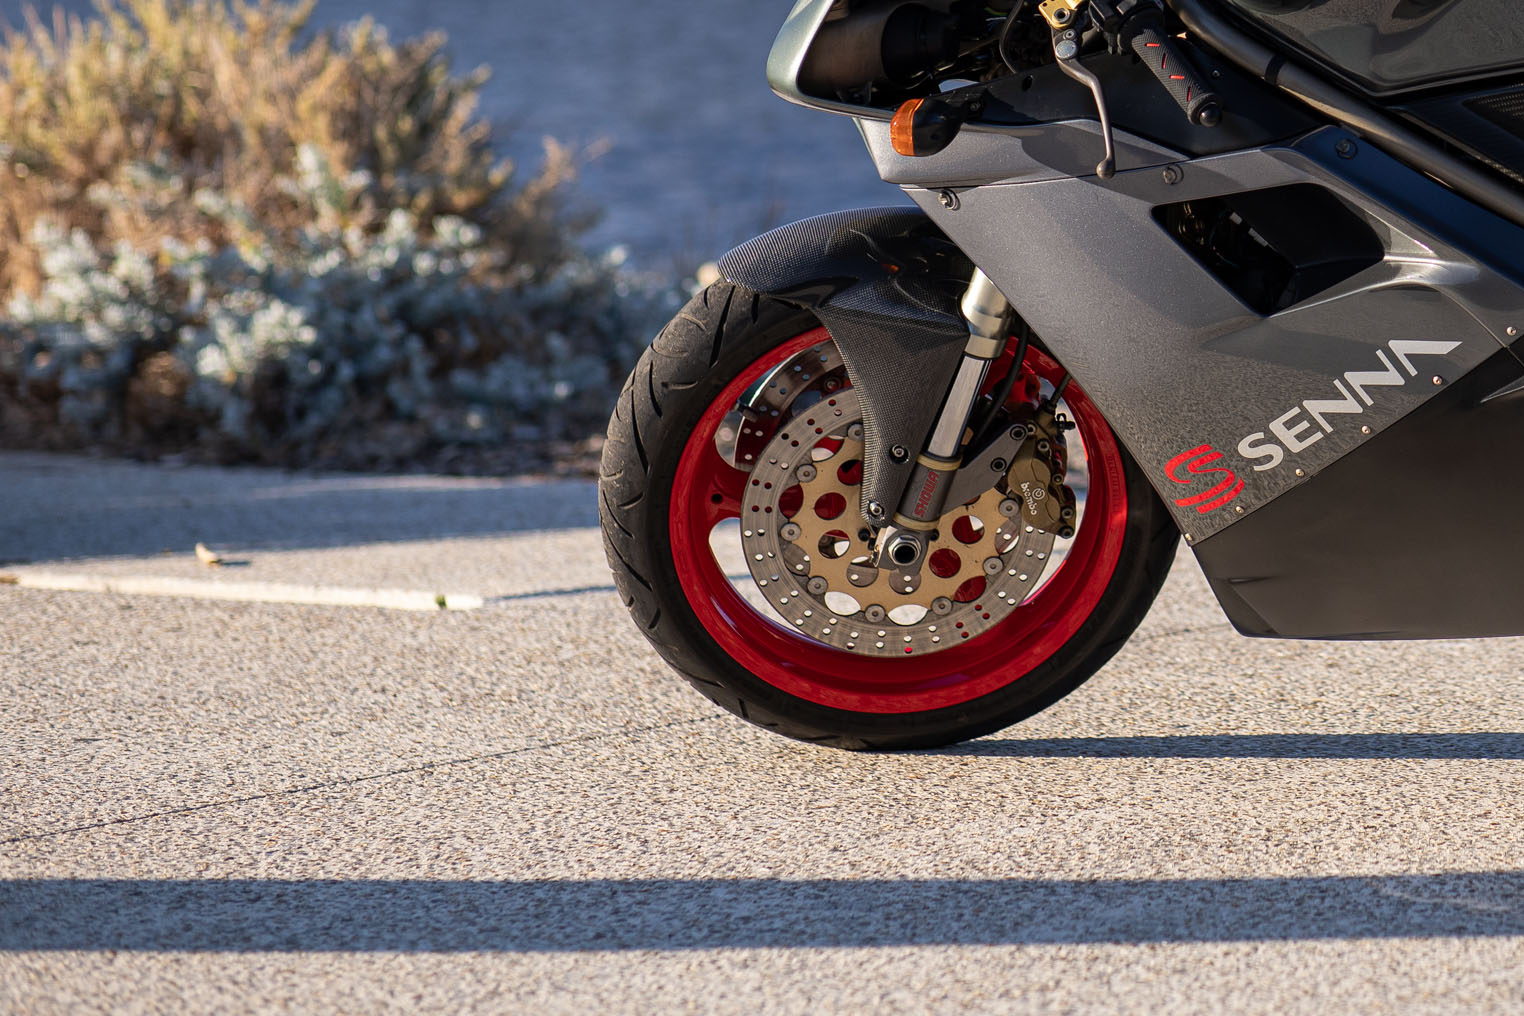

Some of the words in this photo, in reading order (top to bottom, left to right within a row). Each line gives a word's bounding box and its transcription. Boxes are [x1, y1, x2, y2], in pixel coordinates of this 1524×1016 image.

[1237, 339, 1463, 472] SENNA
[914, 471, 940, 519] SHOWA
[1020, 481, 1038, 516] brembo
